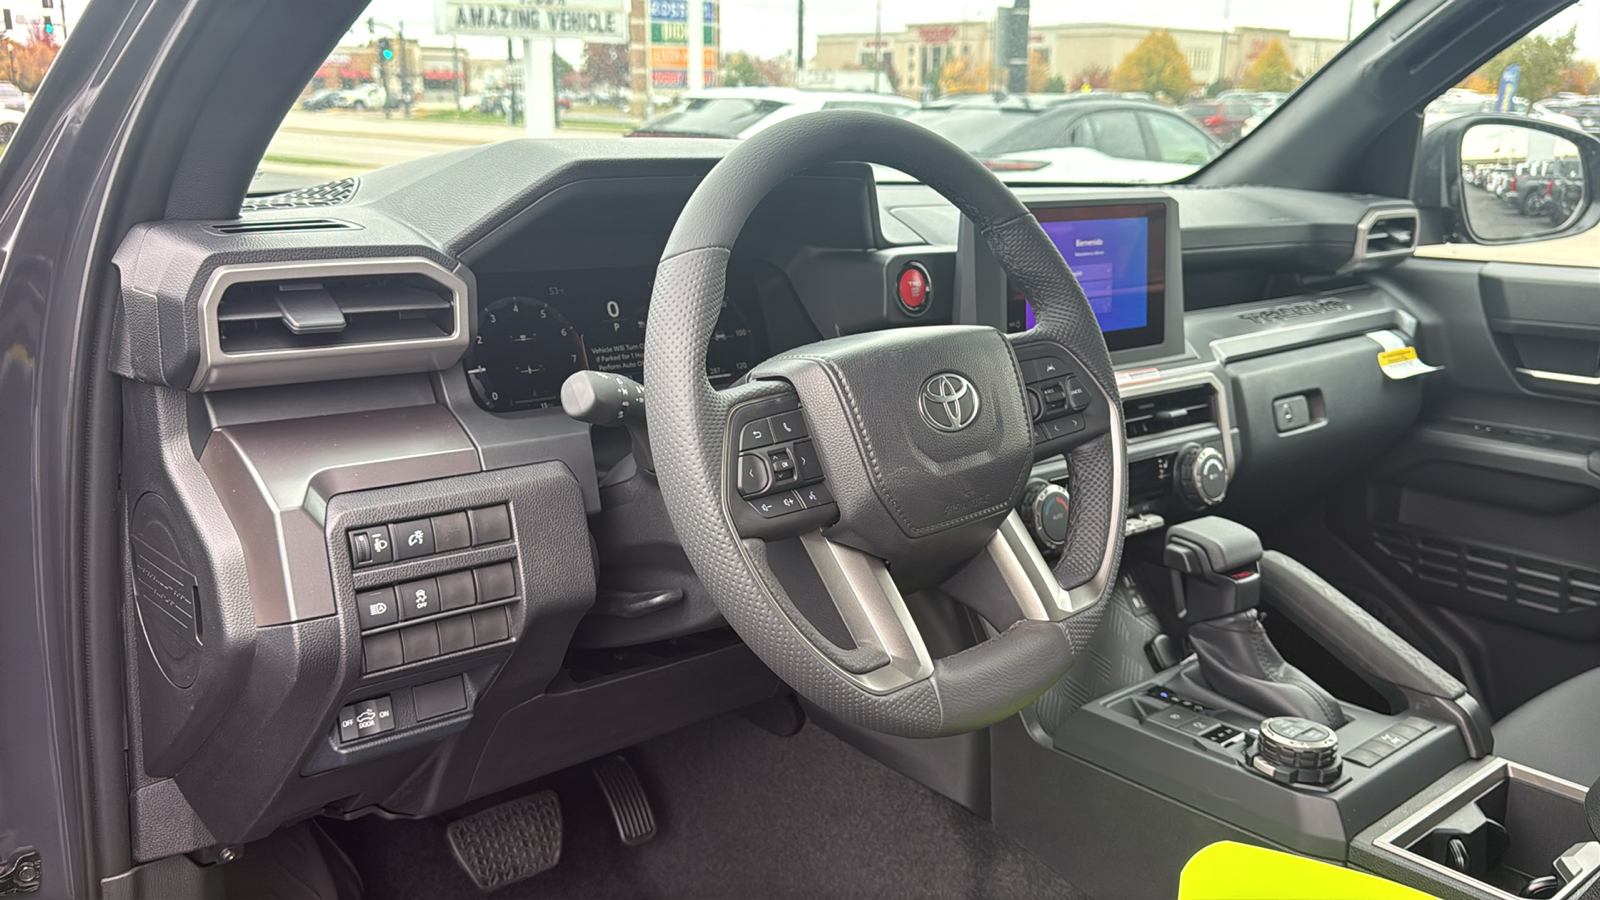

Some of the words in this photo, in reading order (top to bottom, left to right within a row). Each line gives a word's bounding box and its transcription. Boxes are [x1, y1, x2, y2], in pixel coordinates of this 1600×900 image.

[457, 7, 541, 29] AMAZING
[547, 11, 616, 33] VEHICLE
[512, 304, 519, 313] 4
[606, 300, 620, 318] 0
[490, 315, 497, 323] 3
[540, 309, 547, 319] 5
[613, 322, 620, 332] P
[560, 328, 567, 337] 6
[476, 335, 483, 345] 2
[591, 346, 613, 355] Vehicle
[613, 344, 625, 352] Will
[571, 354, 578, 363] 7
[601, 354, 621, 363] Parked
[598, 363, 622, 371] Perform
[622, 361, 637, 369] Auto
[491, 391, 499, 401] 0
[416, 601, 428, 609] OFF
[342, 718, 354, 728] OFF
[358, 719, 375, 729] DOOR
[379, 709, 390, 719] ON
